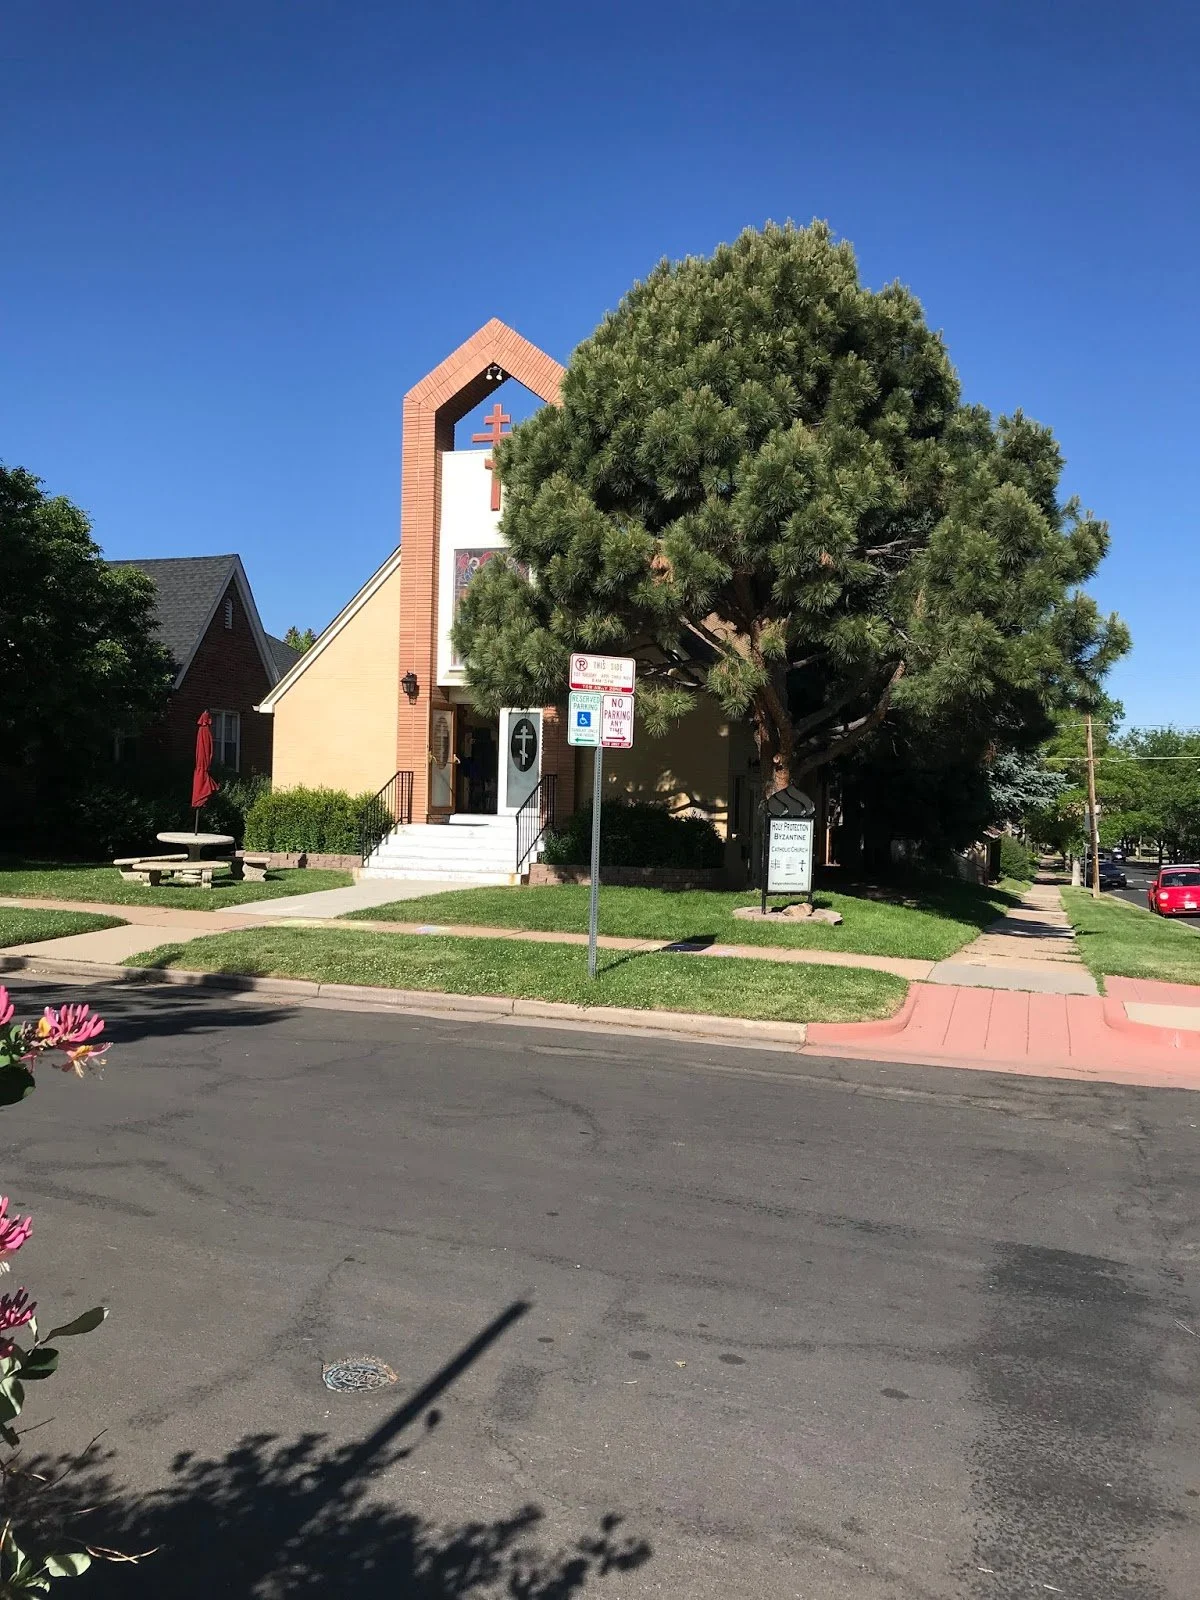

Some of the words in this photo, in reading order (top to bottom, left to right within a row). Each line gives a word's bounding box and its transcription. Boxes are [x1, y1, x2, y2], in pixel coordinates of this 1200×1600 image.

[593, 661, 606, 670] THIS
[610, 663, 623, 672] SIDE
[572, 694, 600, 704] RESERVED
[611, 698, 624, 708] NO
[573, 703, 599, 711] PARKING
[604, 709, 631, 721] PARKING
[609, 727, 624, 736] TIME
[772, 821, 783, 831] HOLY
[784, 822, 808, 831] PROTECTION
